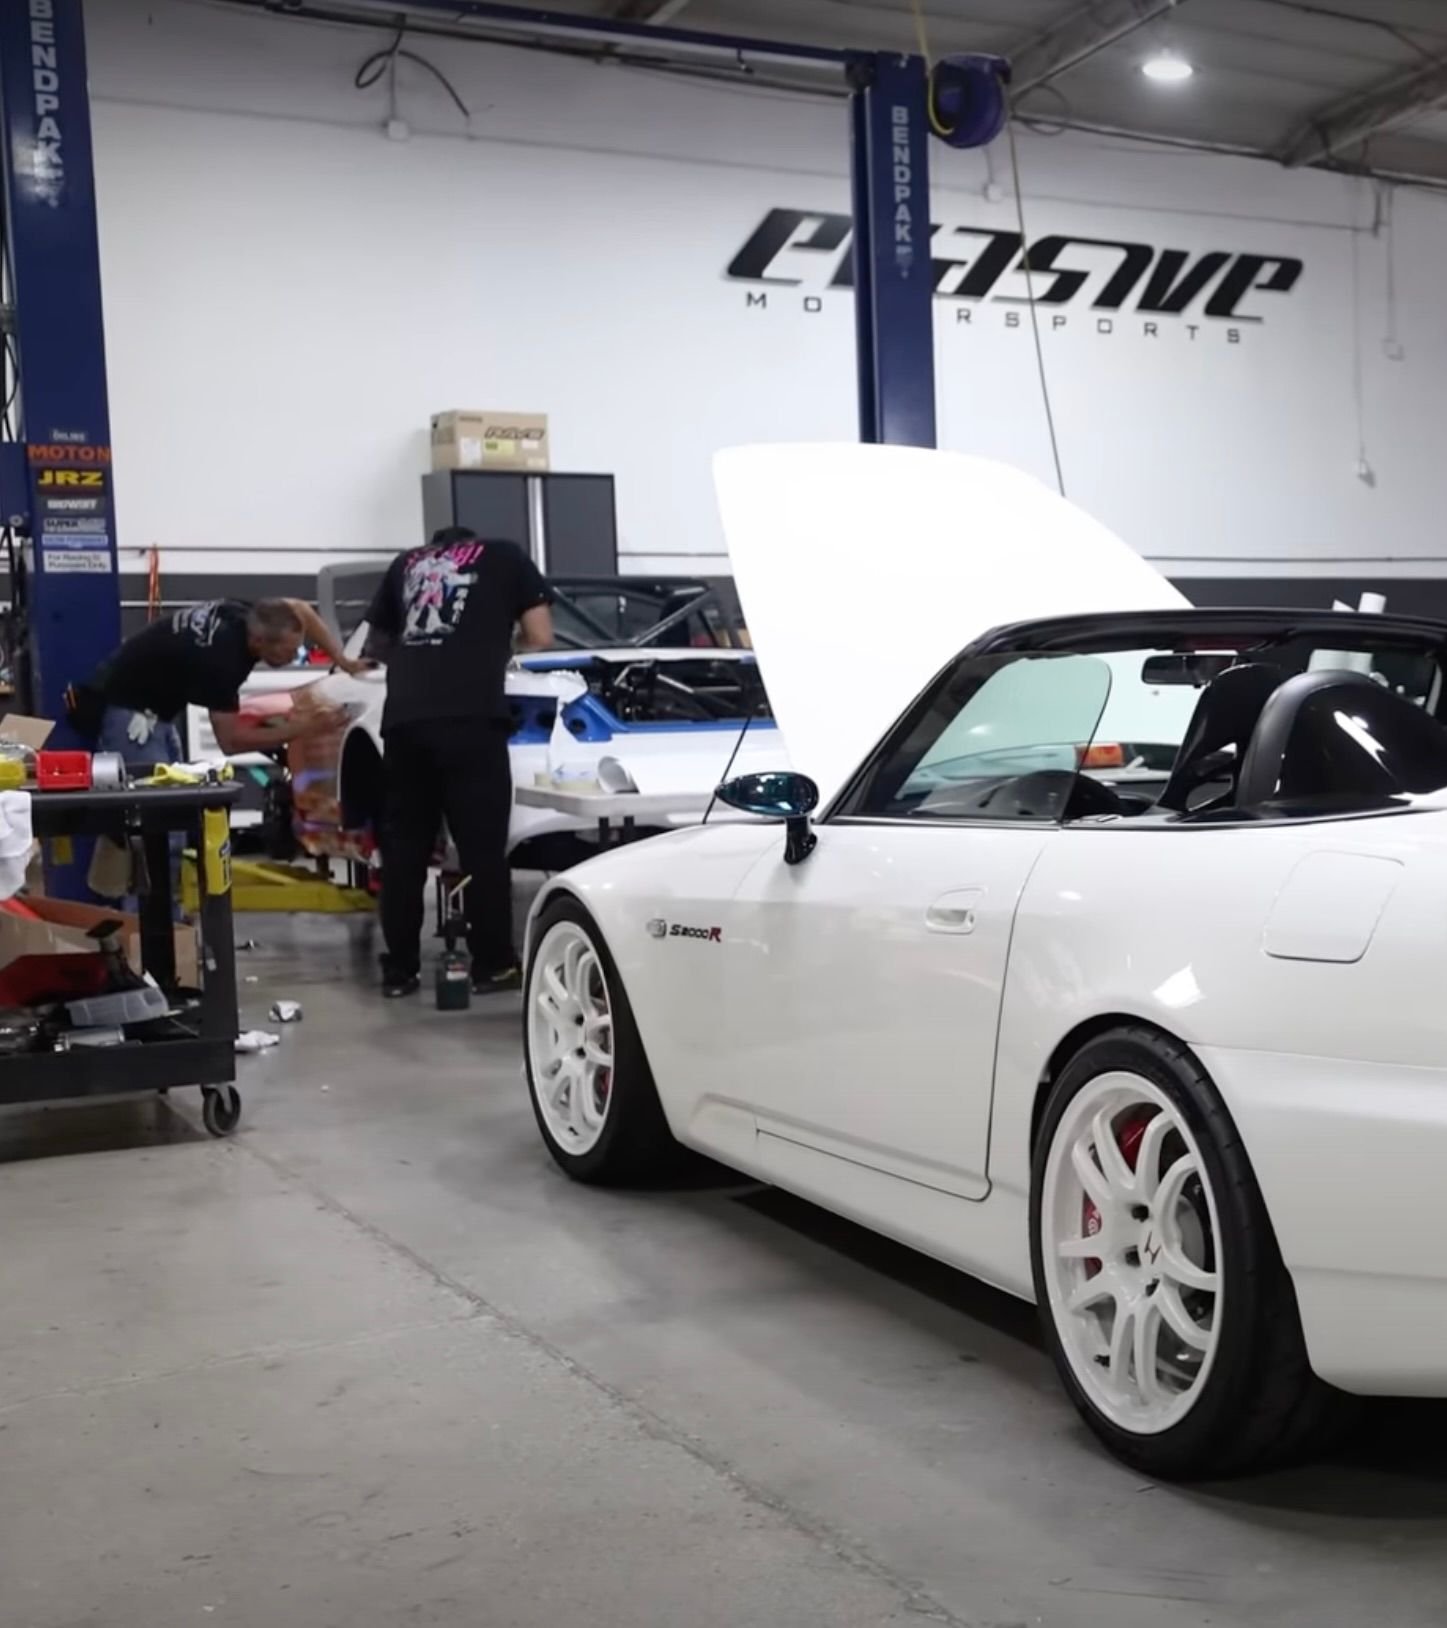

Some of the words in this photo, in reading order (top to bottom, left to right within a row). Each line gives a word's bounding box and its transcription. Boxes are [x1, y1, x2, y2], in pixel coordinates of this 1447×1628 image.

[29, 0, 63, 165] BENDPAK
[891, 105, 912, 242] BENDPAK
[746, 291, 1240, 344] MORSPORTS
[27, 445, 111, 461] MOTON
[38, 470, 103, 486] JRZ
[669, 924, 722, 943] S2000R
